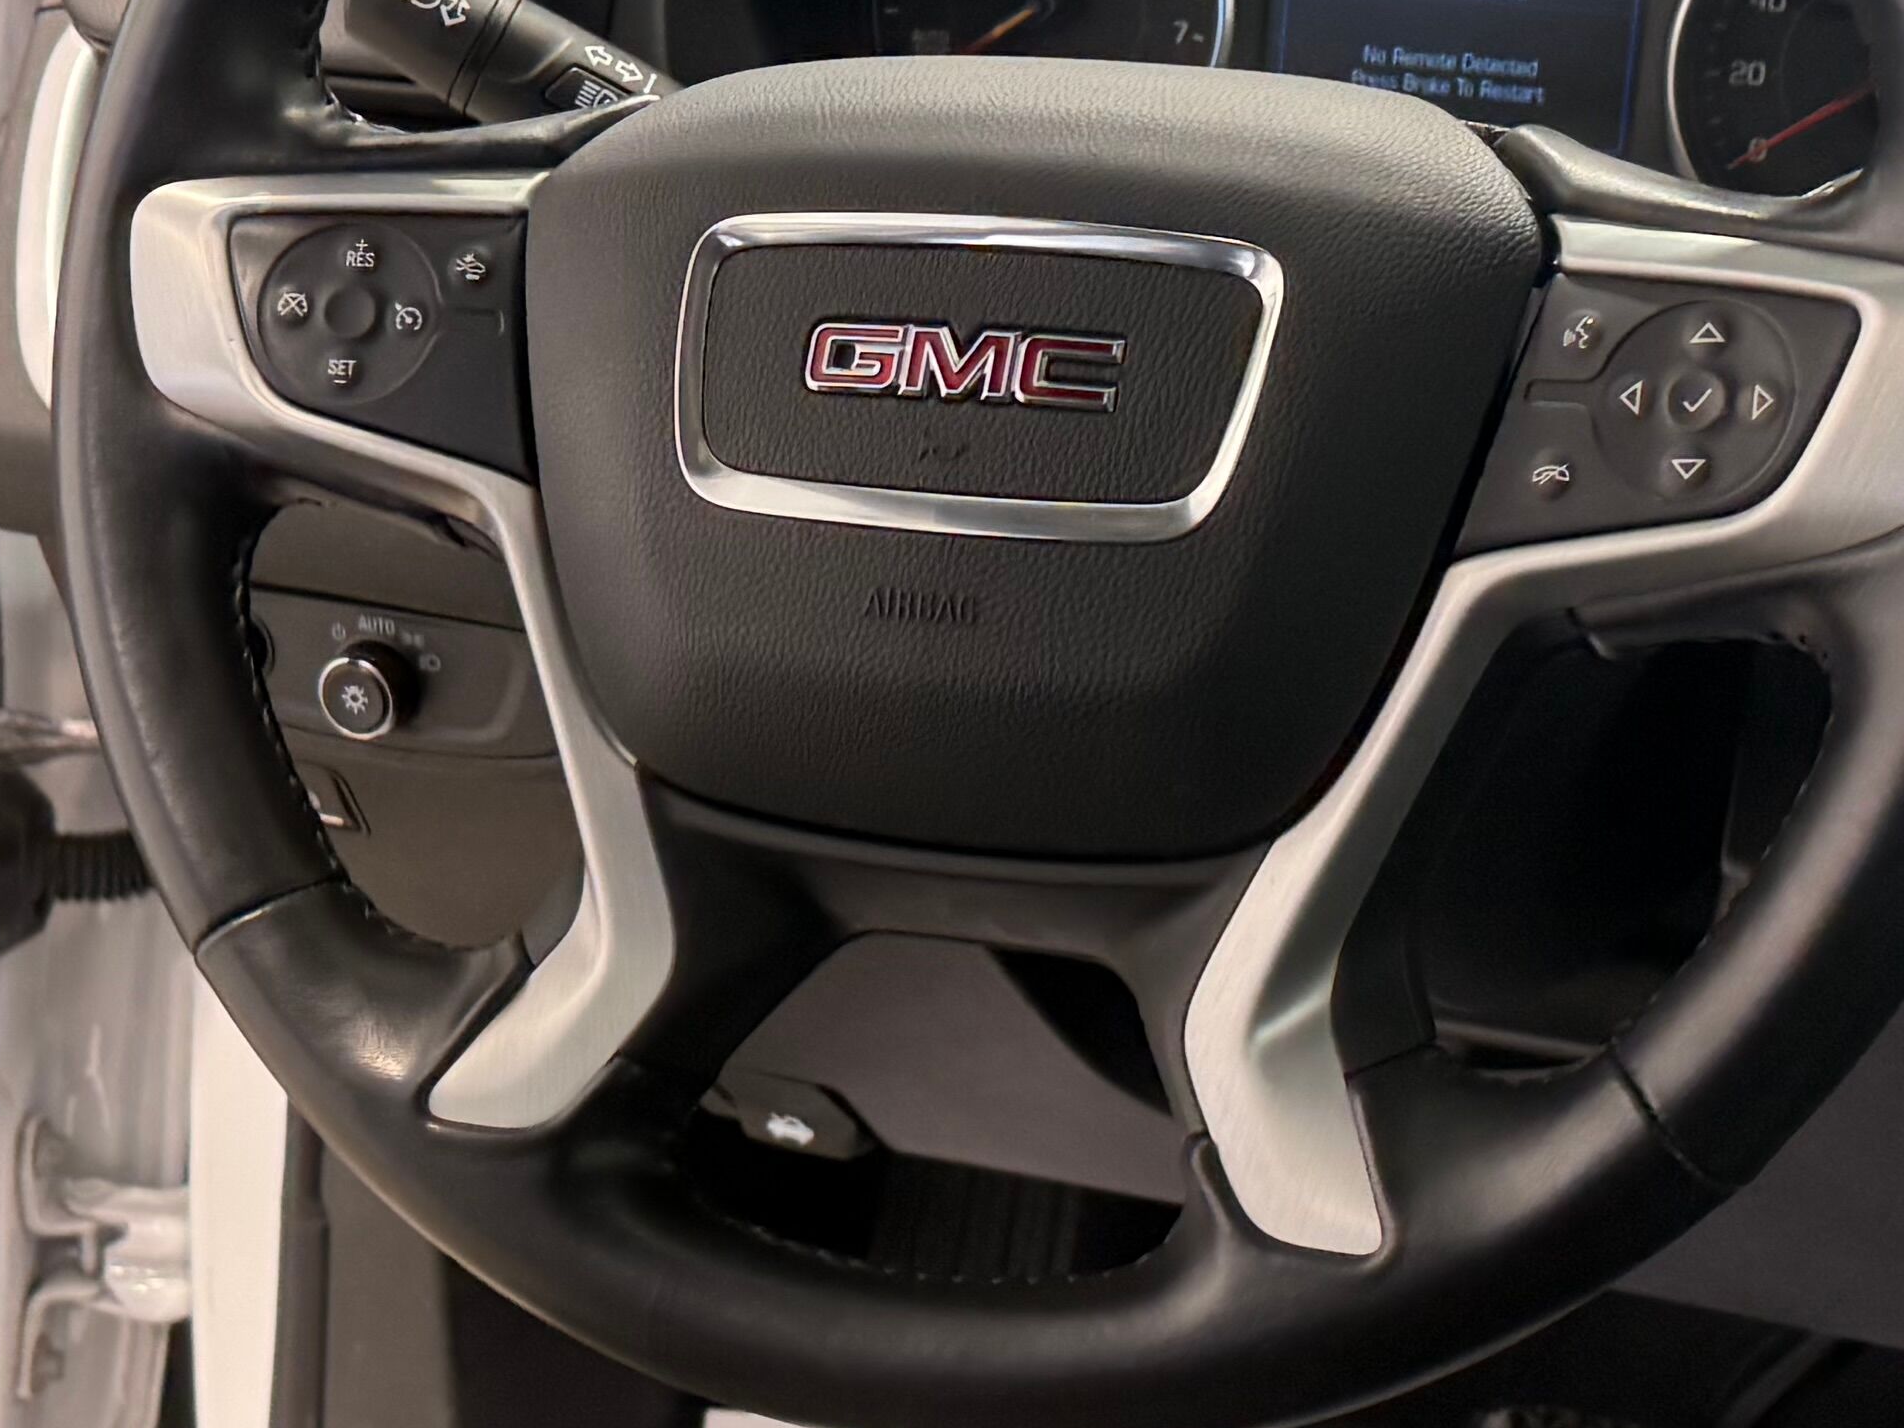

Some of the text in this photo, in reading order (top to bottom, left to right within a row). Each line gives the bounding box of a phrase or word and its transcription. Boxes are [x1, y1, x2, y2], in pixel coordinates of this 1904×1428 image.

[1173, 21, 1188, 45] 7
[1363, 44, 1538, 77] No Remote Detected
[1728, 59, 1766, 86] 20
[1457, 77, 1474, 98] To
[1480, 80, 1544, 104] Restart
[346, 250, 375, 267] RES
[328, 359, 356, 378] SET
[804, 321, 1126, 413] GMC
[357, 614, 395, 636] AUTO
